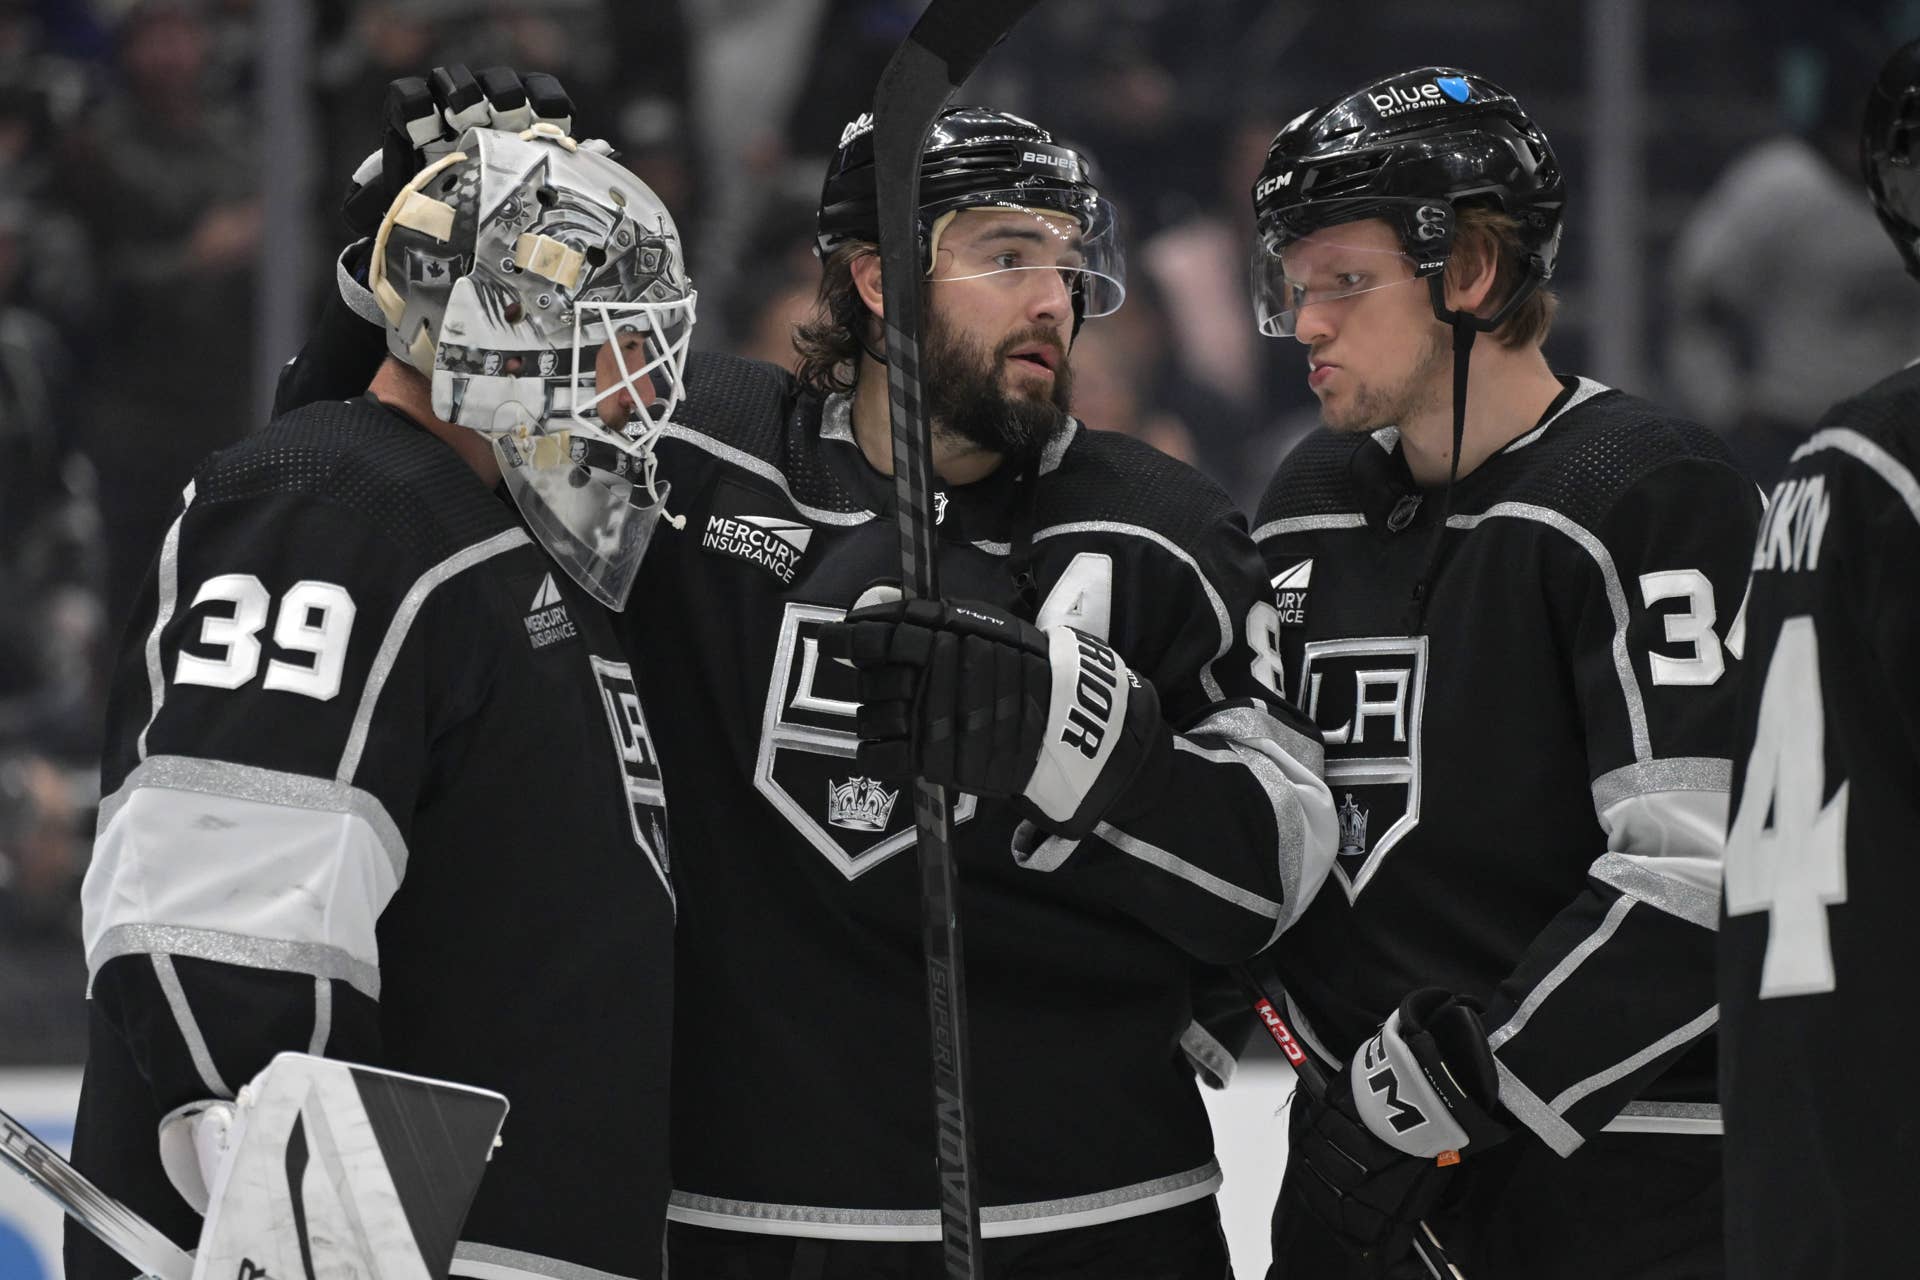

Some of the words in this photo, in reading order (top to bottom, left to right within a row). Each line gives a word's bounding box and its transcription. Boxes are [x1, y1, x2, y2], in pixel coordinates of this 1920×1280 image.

[1367, 82, 1441, 112] blue
[1379, 97, 1447, 118] CALIFORNIA
[1256, 170, 1294, 201] CCM
[1419, 261, 1445, 269] CCM
[701, 531, 796, 584] INSURANCE
[705, 514, 802, 568] MERCURY
[523, 604, 569, 634] MERCURY
[1035, 551, 1113, 645] A
[173, 572, 358, 702] 39
[1723, 614, 1851, 1001] 4
[1260, 1005, 1303, 1061] CCM
